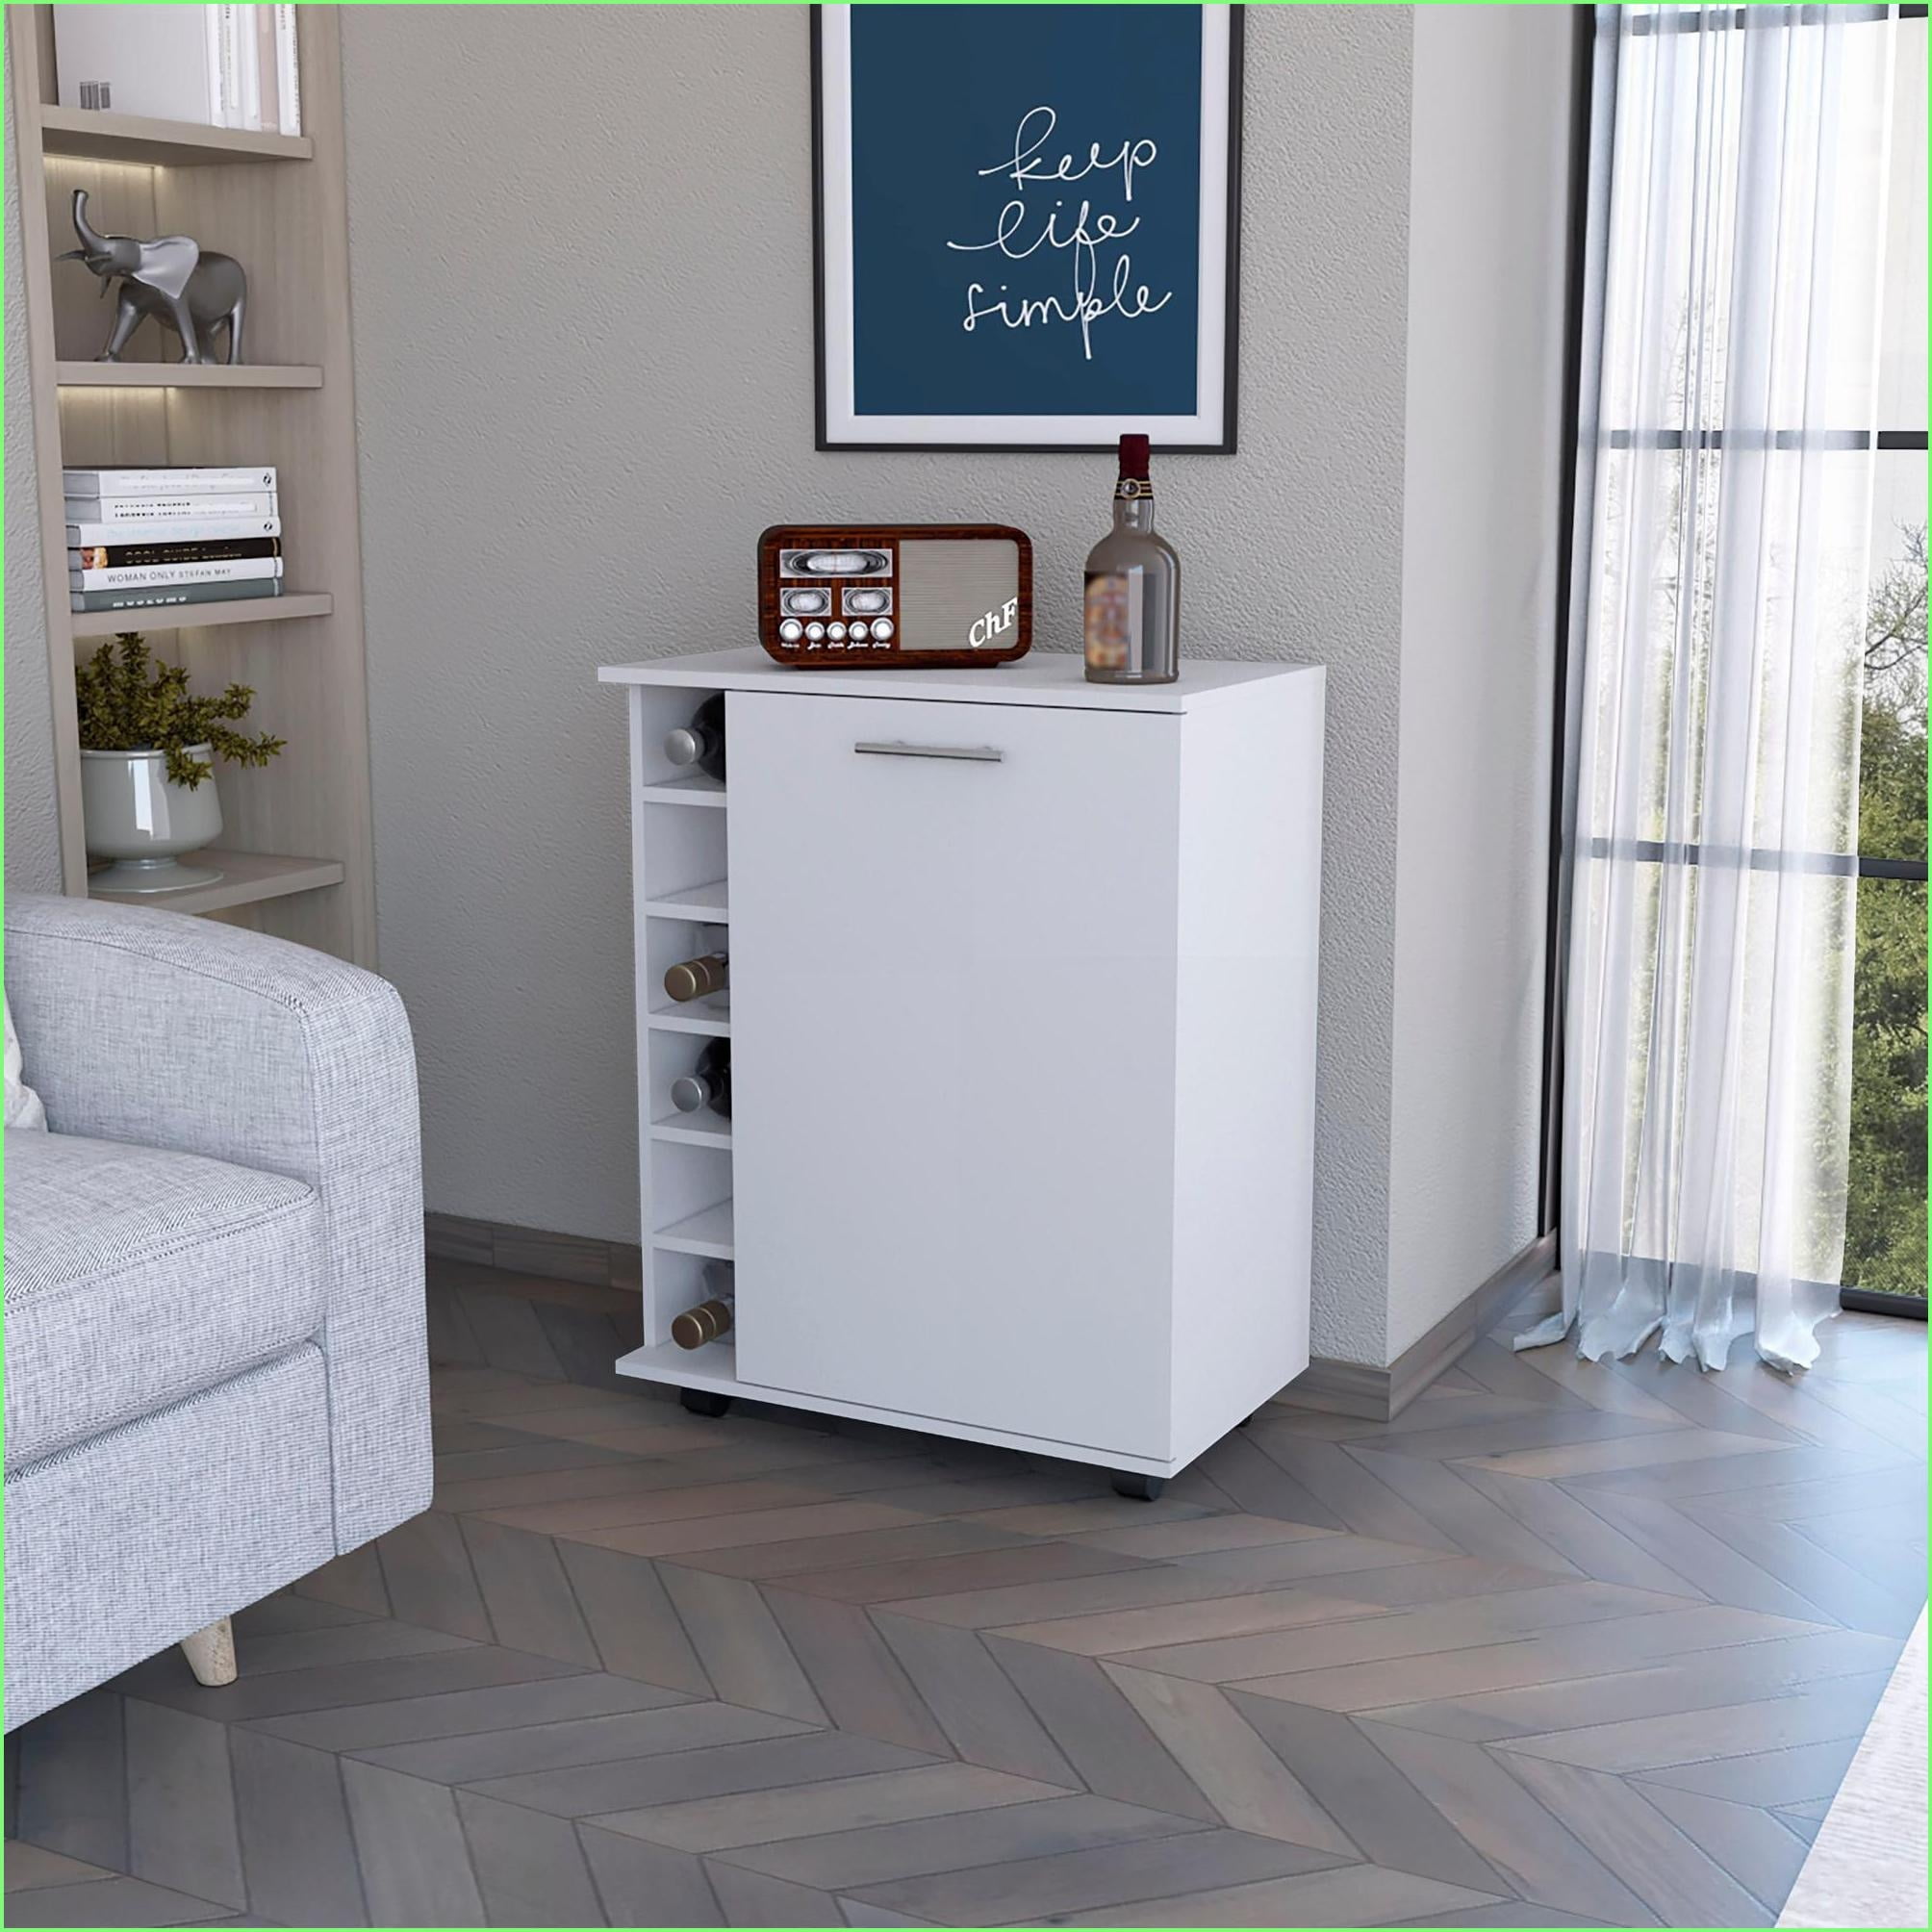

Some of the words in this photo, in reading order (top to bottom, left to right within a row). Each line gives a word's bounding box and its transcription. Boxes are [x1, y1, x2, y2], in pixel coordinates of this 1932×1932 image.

[978, 106, 1157, 202] keep
[946, 199, 1140, 307] life
[963, 253, 1173, 360] simple
[107, 572, 146, 583] WOMAN
[149, 571, 177, 581] ONLY
[179, 569, 212, 578] STEFAN
[969, 597, 1018, 648] ChF
